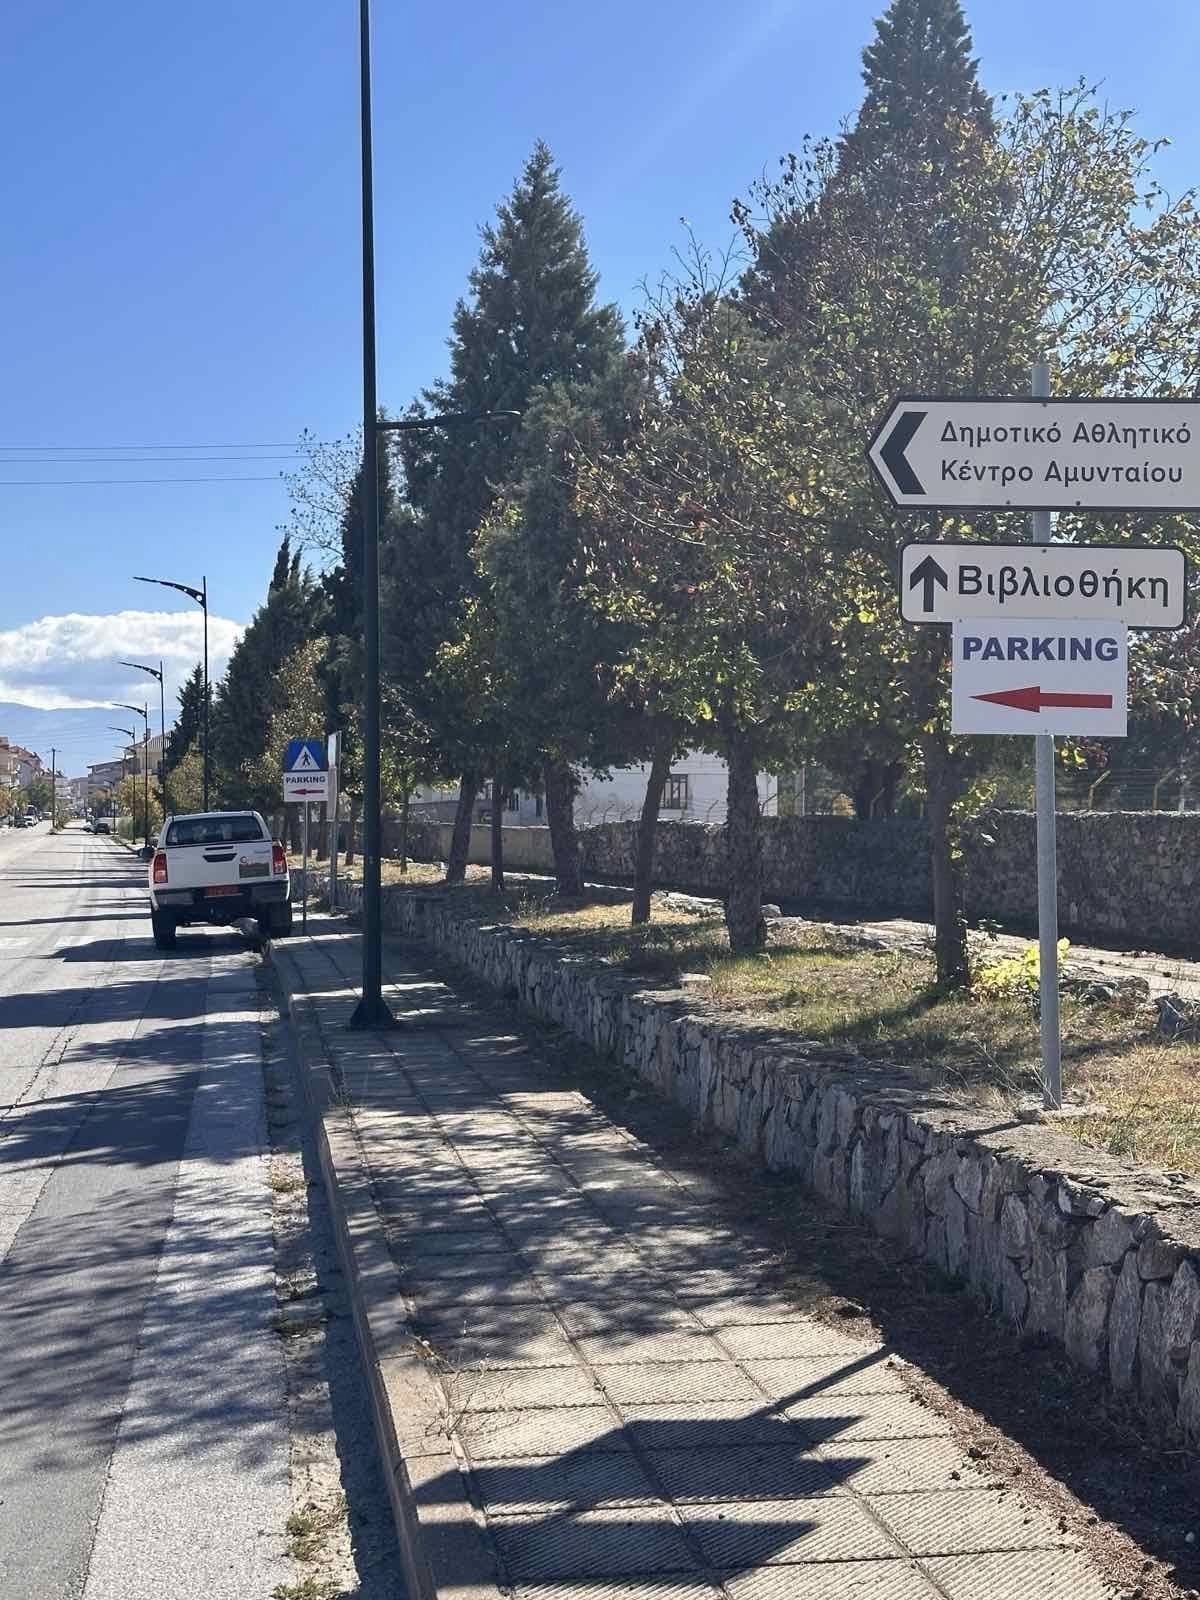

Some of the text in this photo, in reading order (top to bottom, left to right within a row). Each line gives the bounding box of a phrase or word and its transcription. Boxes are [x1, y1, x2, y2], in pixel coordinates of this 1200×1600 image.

[940, 421, 1191, 449] Δημοτικό Αθλητικό
[940, 459, 1183, 487] Κέντρο Αμυνταίου
[957, 565, 1169, 607] Βιβλιοθήκη
[962, 637, 1119, 661] PARKING
[285, 775, 326, 784] PARKING
